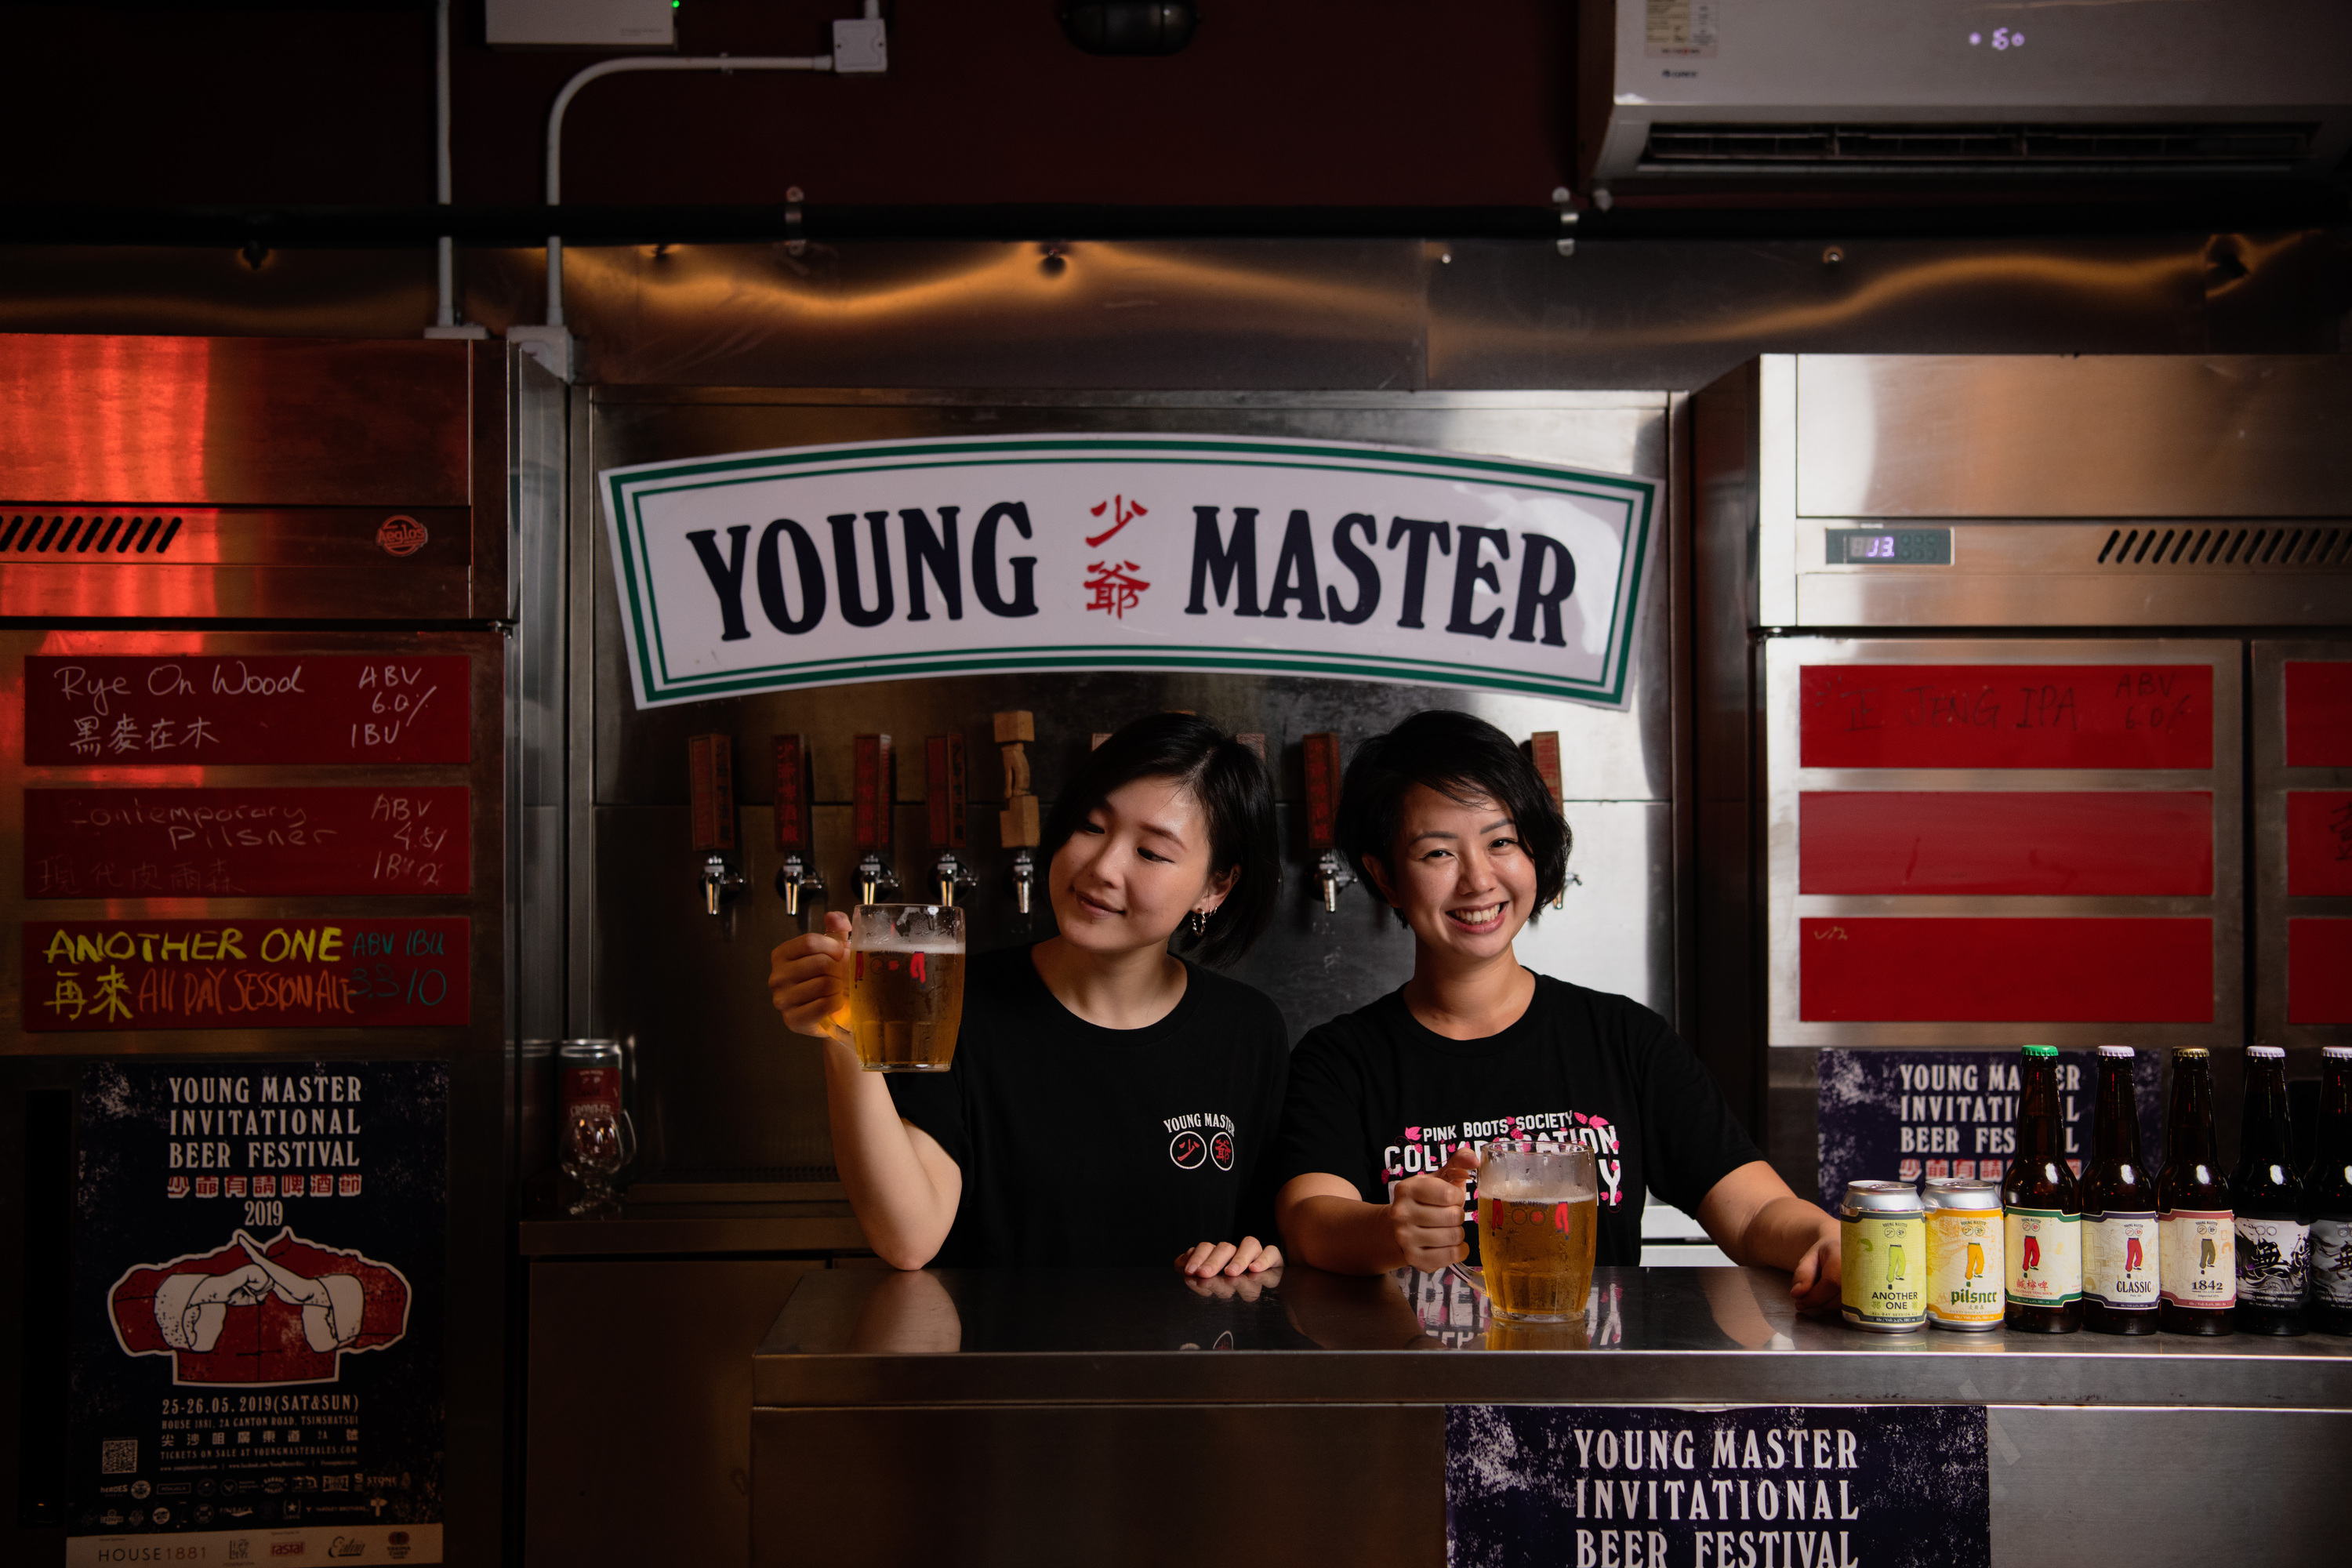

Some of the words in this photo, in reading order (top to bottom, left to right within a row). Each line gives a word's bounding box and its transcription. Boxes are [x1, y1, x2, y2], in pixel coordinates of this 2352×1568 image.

[1085, 493, 1151, 620] 少爺
[687, 502, 1038, 641] YOUNG
[1184, 506, 1577, 647] MASTER
[54, 666, 131, 715] Rye
[148, 664, 196, 695] On
[212, 662, 305, 695] Wood
[359, 666, 422, 689] ABV
[2016, 685, 2078, 731] IPA
[69, 713, 220, 757] 黑麥在木
[371, 793, 433, 822] ABV
[169, 825, 339, 851] Pilsner
[42, 928, 248, 965] ANOTHER
[260, 926, 344, 963] ONE
[351, 931, 394, 958] ABV
[405, 929, 444, 956] IBU
[43, 964, 134, 1022] 再來
[169, 1076, 250, 1104] YOUNG
[261, 1075, 362, 1103] MASTER
[1900, 1064, 1979, 1091] YOUNG
[1987, 1064, 2081, 1091] MAER
[169, 1108, 361, 1136] INVITATIONAL
[1900, 1095, 2081, 1123] INVITATIL
[1163, 1113, 1202, 1134] YOUNG
[1203, 1112, 1236, 1138] MASTER
[1422, 1124, 1457, 1142] PINK
[1463, 1118, 1509, 1138] BOOTS
[1515, 1109, 1573, 1131] SOCIETY
[1900, 1126, 1960, 1153] BEER
[1975, 1126, 2080, 1153] FESL
[169, 1141, 231, 1168] BEER
[247, 1141, 361, 1168] FESTIVAL
[244, 1200, 284, 1226] 2019
[1871, 1292, 1918, 1301] ANOTHER
[1951, 1288, 1998, 1305] pilsner
[2116, 1280, 2152, 1294] CLASSIC
[2191, 1279, 2223, 1290] 1842
[161, 1419, 191, 1430] HOUSE
[220, 1417, 230, 1428] 2A
[233, 1417, 268, 1428] CANTON
[160, 1450, 198, 1461] TICKETS
[215, 1448, 237, 1458] SALE
[240, 1448, 250, 1457] AT
[1573, 1428, 1696, 1470] YOUNG
[1711, 1428, 1859, 1469] MASTER
[1575, 1479, 1860, 1521] INVITATIONAL
[99, 1548, 162, 1562] HOUSE
[165, 1546, 206, 1561] 1881
[1576, 1529, 1669, 1568] BEER
[1694, 1529, 1860, 1568] FESTIVAL
